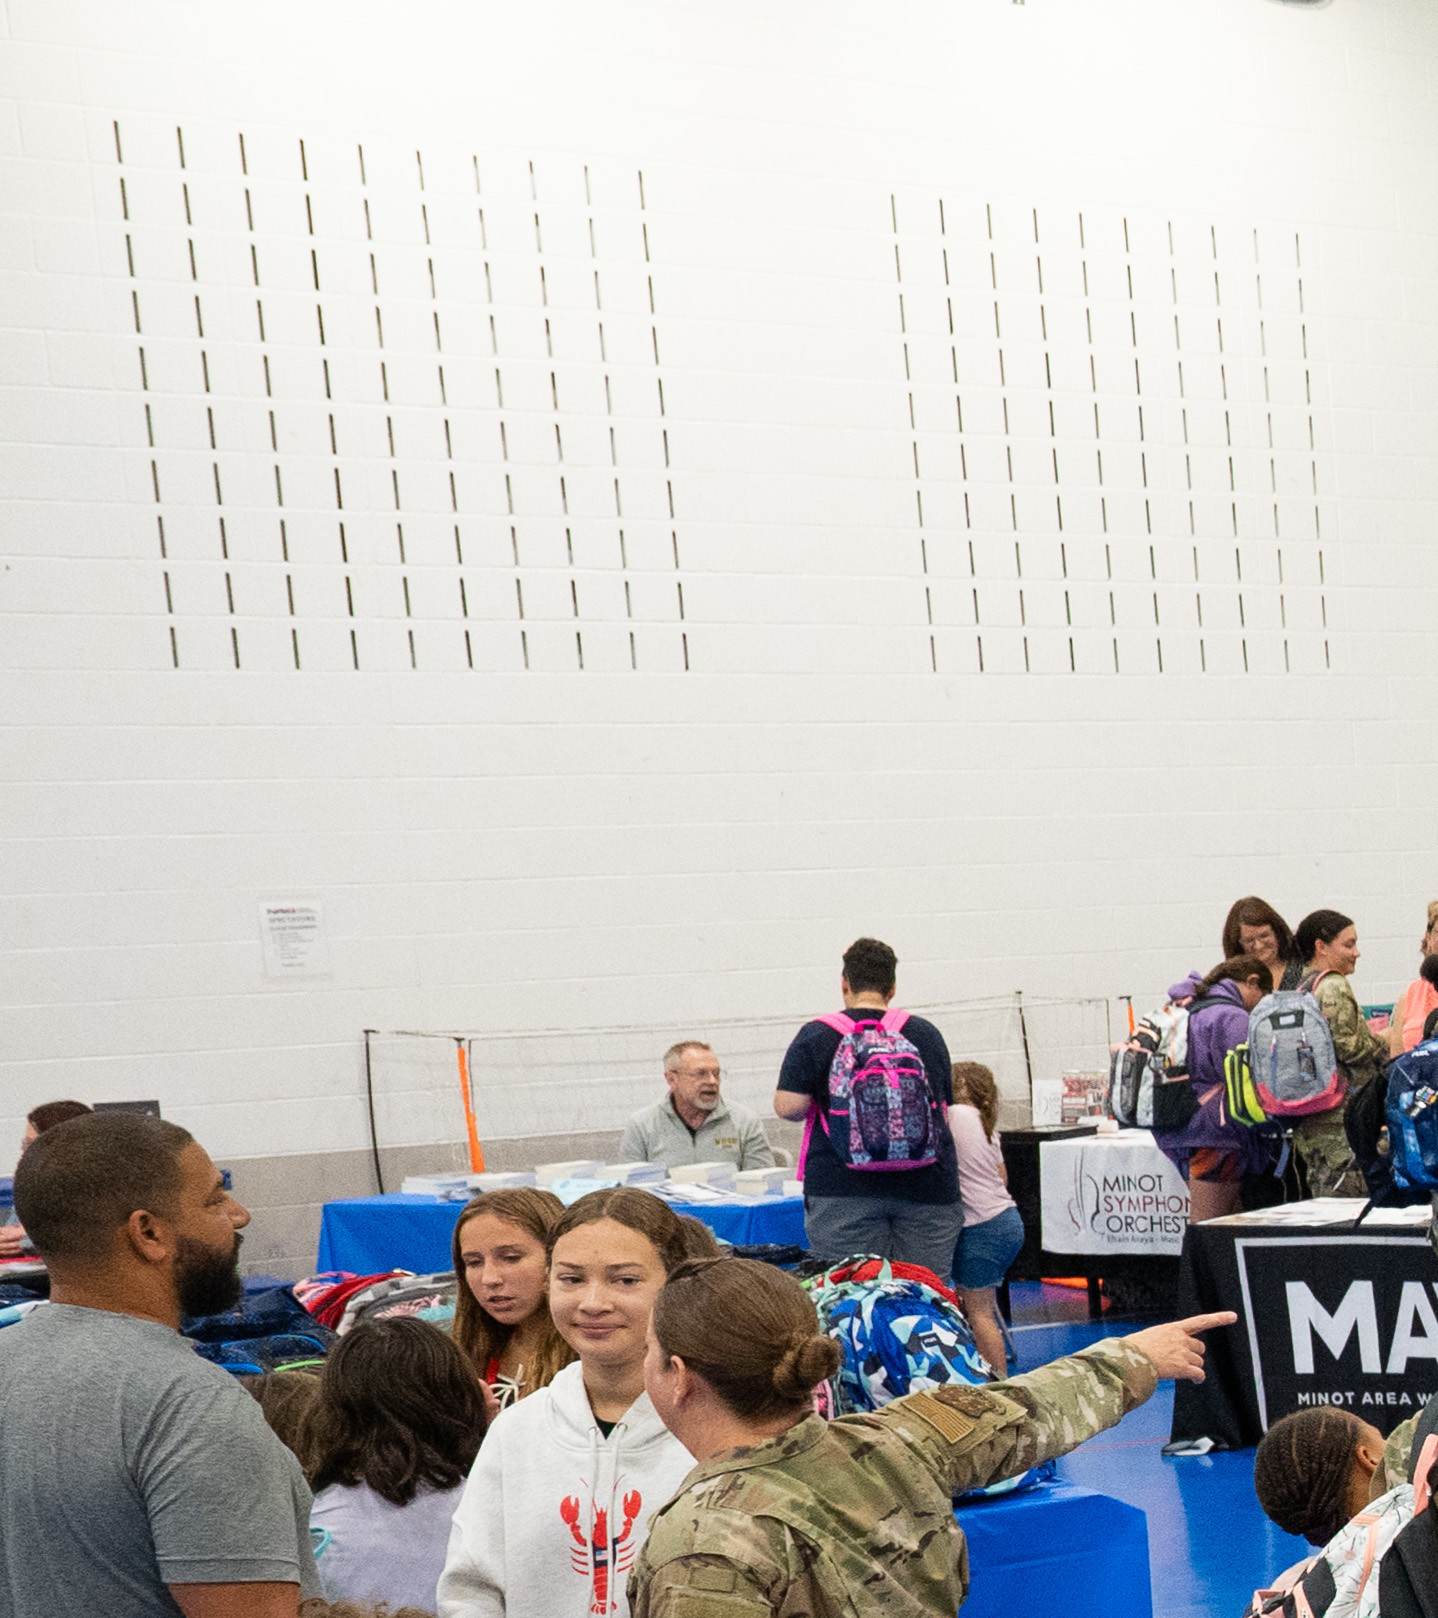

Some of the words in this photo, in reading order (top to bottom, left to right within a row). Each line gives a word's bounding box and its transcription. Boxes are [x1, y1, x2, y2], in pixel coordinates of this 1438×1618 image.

[1103, 1175, 1163, 1192] MINOT
[1104, 1195, 1191, 1213] SYMPHON
[1106, 1215, 1190, 1233] ORCHEST
[1298, 1391, 1354, 1405] MINOT
[1362, 1391, 1412, 1405] AREA
